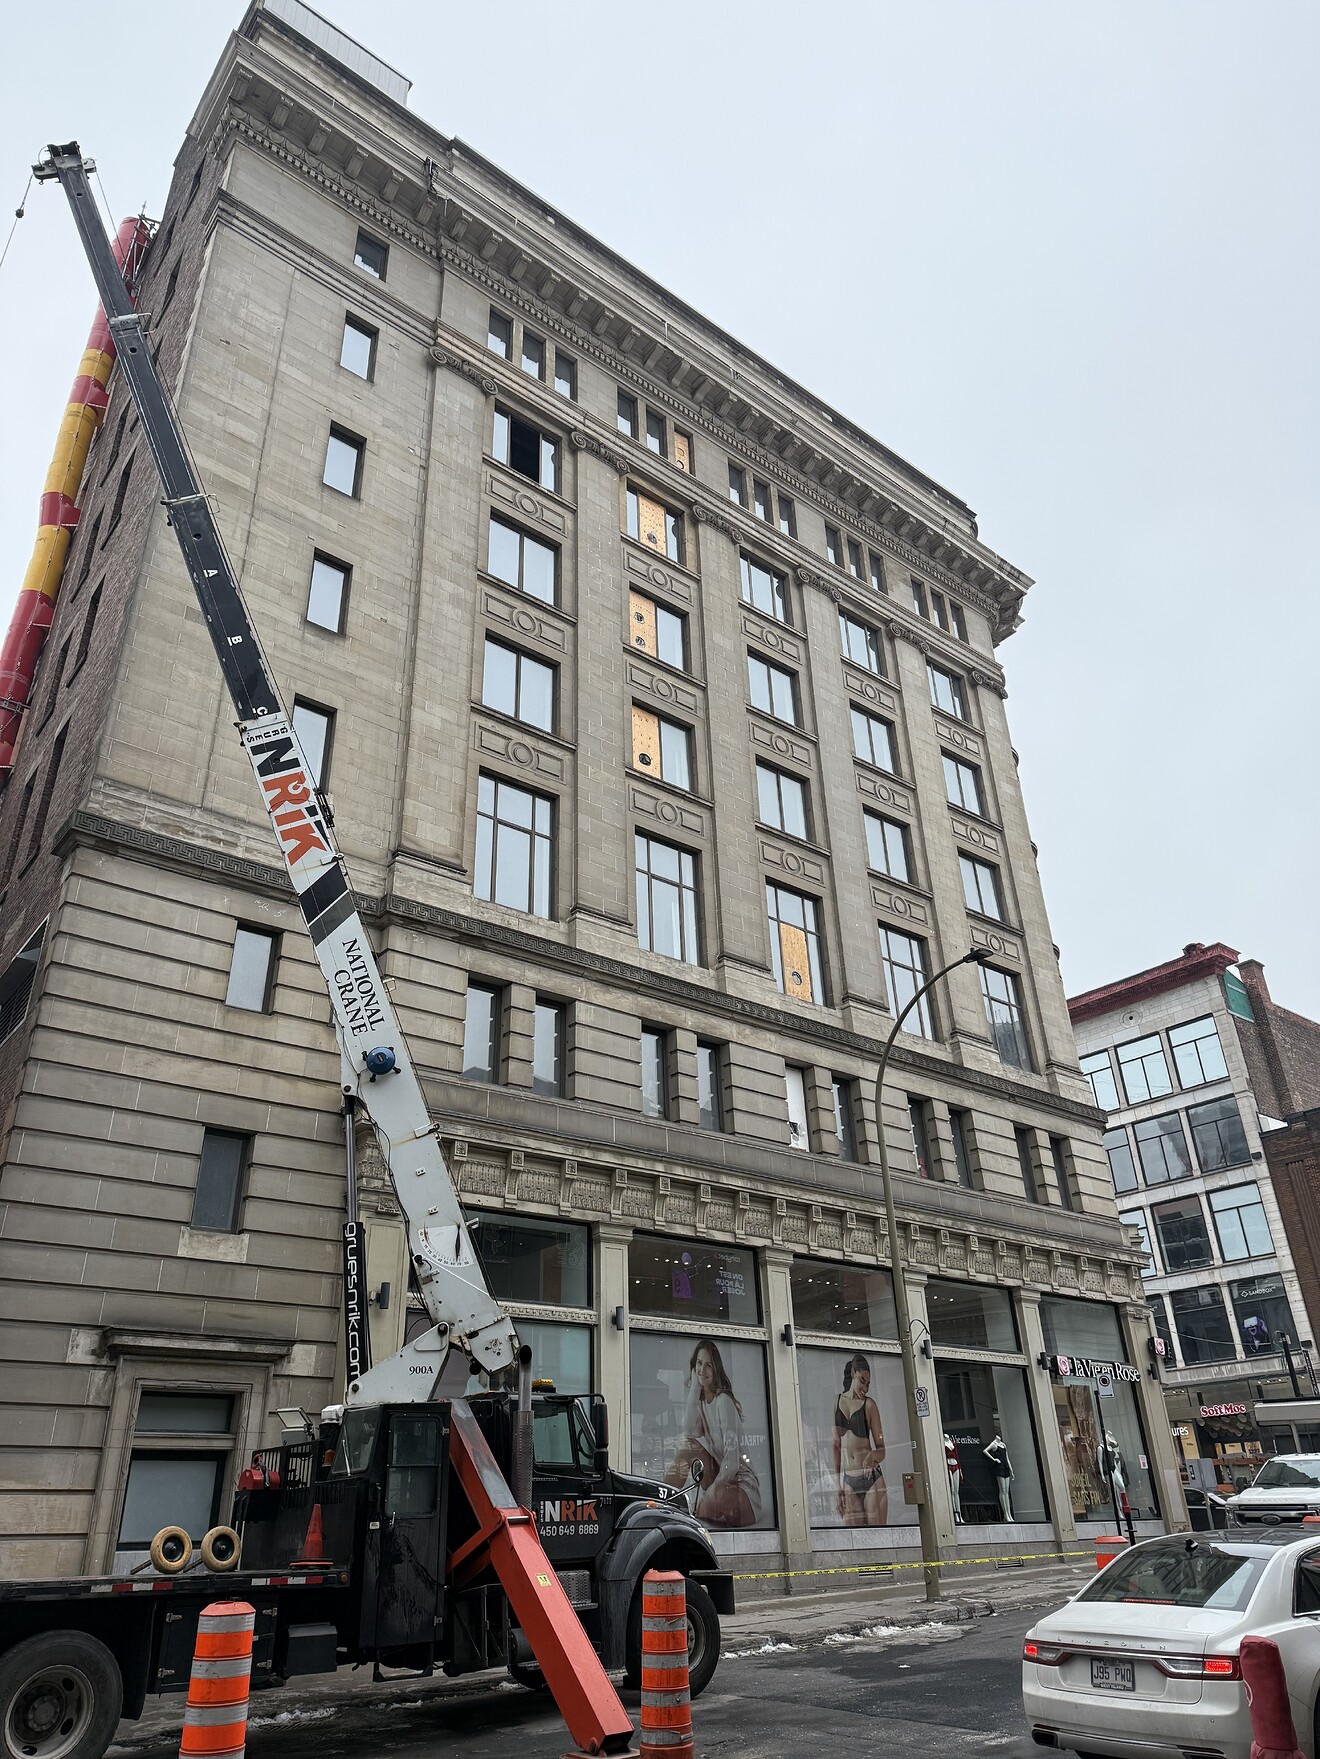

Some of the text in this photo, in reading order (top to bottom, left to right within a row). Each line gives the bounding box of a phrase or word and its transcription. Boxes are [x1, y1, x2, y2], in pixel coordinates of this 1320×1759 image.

[256, 706, 268, 716] C
[246, 727, 289, 743] GRUES
[341, 938, 385, 1032] NATIONAL
[334, 969, 368, 1037] CRANE
[409, 1365, 434, 1376] 900A
[1114, 1362, 1141, 1382] Rose
[658, 1487, 668, 1499] 37
[540, 1523, 599, 1537] 450 649 6869
[1057, 1636, 1166, 1650] LINCOLN
[1093, 1665, 1110, 1680] J95
